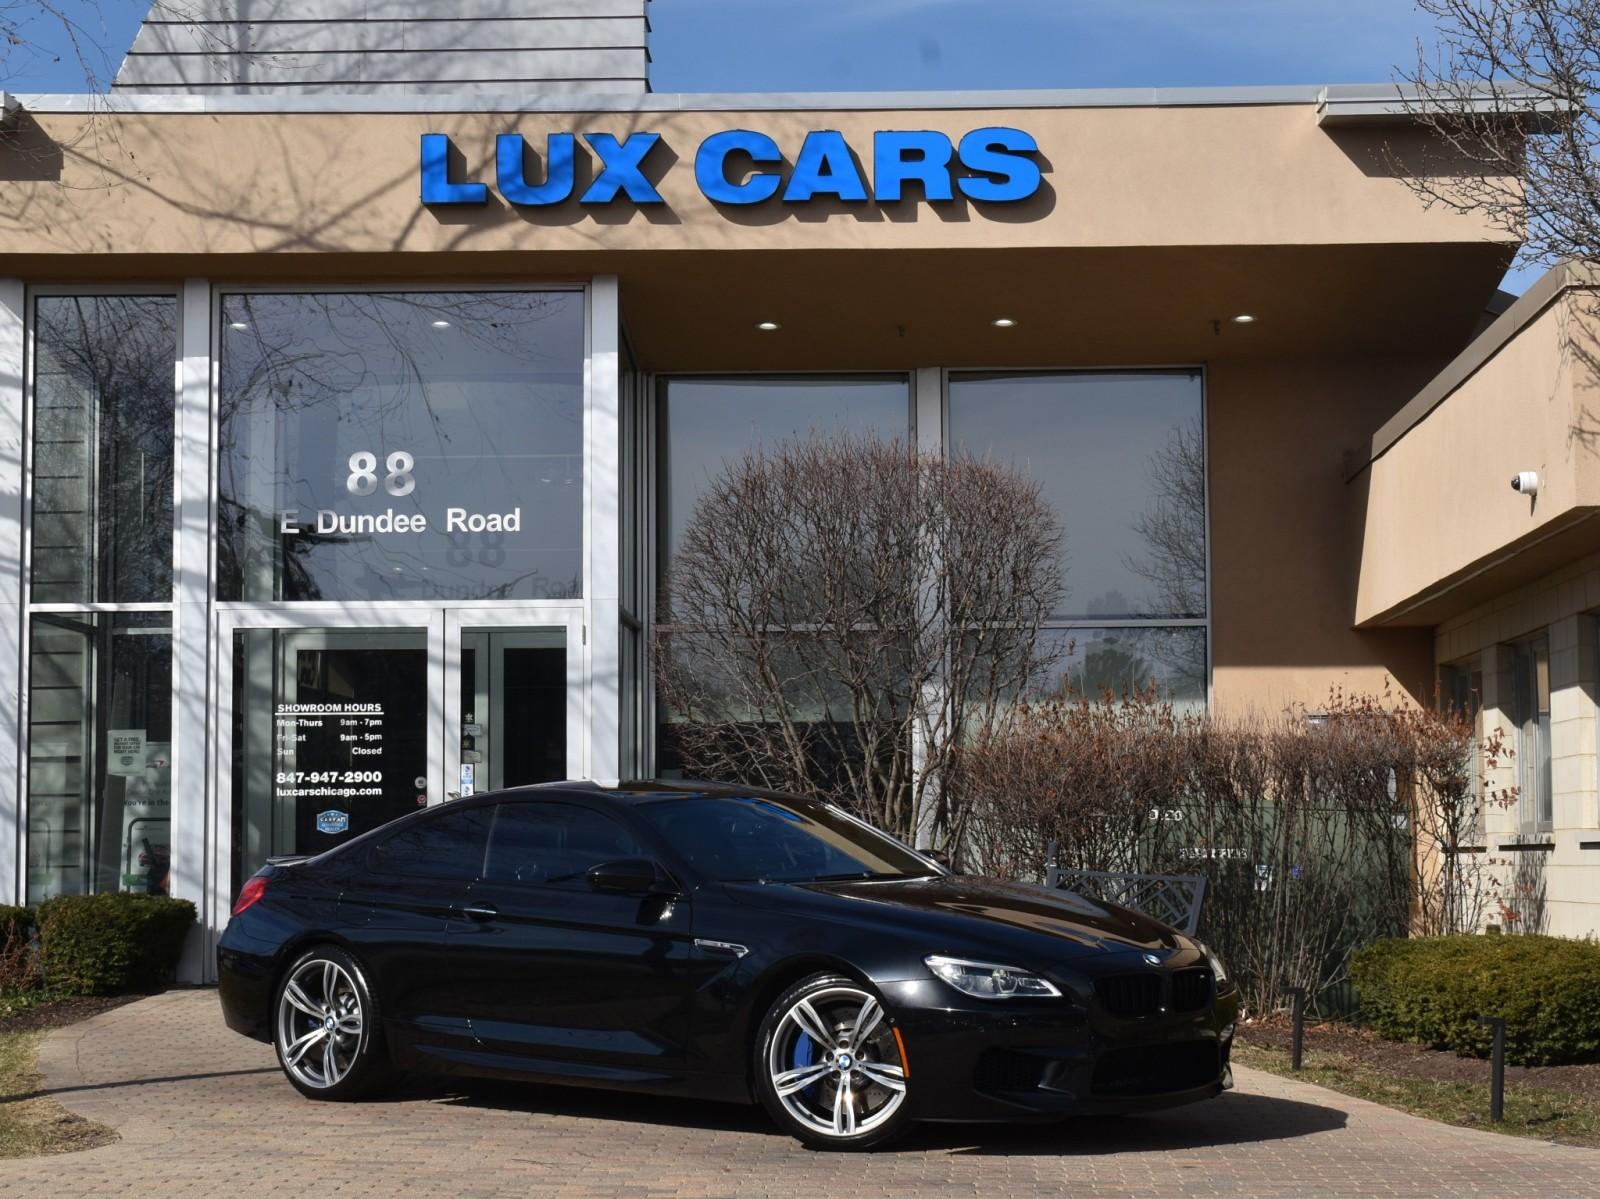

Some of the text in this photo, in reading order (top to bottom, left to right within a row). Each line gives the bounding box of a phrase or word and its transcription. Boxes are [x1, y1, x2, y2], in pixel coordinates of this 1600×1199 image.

[420, 127, 1041, 205] LUX CARS
[346, 450, 416, 497] 88
[280, 507, 521, 534] E Dundee Road
[277, 703, 382, 712] SHOWROOM HOURS
[276, 718, 323, 727] Mon-Thurs
[340, 718, 358, 726] 9am
[364, 718, 382, 727] 7pm
[276, 734, 307, 742] Fri-Sat
[364, 733, 382, 742] 5pm
[277, 747, 382, 756] Sun Closed
[276, 771, 383, 783] 847-947-2900
[276, 787, 383, 797] luxcarschicago.com
